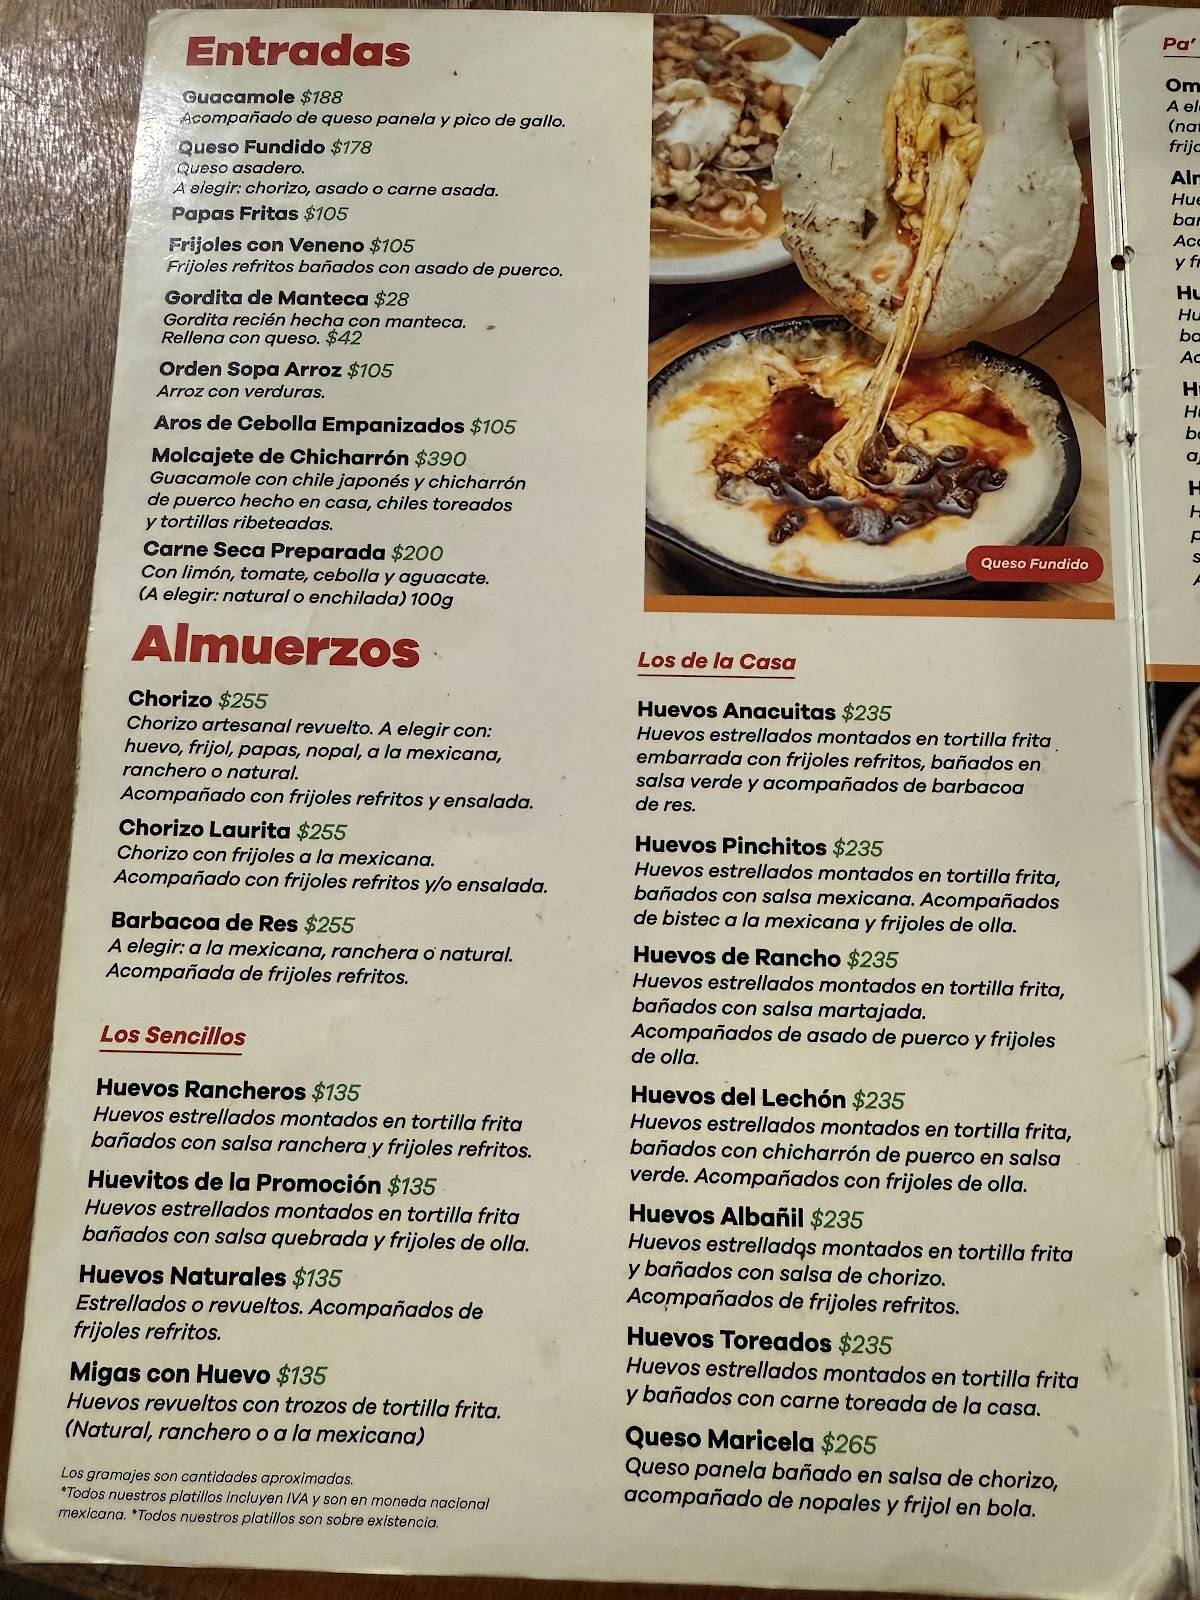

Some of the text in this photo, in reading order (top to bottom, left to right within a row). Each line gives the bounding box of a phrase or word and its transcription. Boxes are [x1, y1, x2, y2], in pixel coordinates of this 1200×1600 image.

[186, 33, 410, 67] Entradas
[182, 89, 343, 105] Guacamole $188
[1166, 100, 1178, 112] A
[178, 139, 372, 157] Queso Fundido $178
[172, 205, 349, 223] Papas Fritas $105
[169, 236, 415, 255] Frijoles con Veneno $105
[1176, 258, 1185, 270] y
[165, 289, 409, 308] Gordita de Manteca $28
[161, 329, 362, 347] Rellena con queso. $42
[159, 361, 394, 379] Orden Sopa Arroz $105
[153, 414, 517, 436] Aros de Cebolla Empanizados $105
[152, 447, 467, 468] Molcajete de Chicharrón $390
[150, 471, 526, 491] Guacamole con chile japonés y chicharrón
[144, 541, 443, 562] Carne Seca Preparada $200
[981, 557, 1089, 570] Queso Fundido
[131, 623, 420, 668] Almuerzos
[638, 652, 796, 670] Los de la Casa
[128, 689, 268, 710] Chorizo $255
[638, 701, 892, 723] Huevos Anacuitas $235
[636, 796, 695, 812] de res.
[119, 818, 348, 841] Chorizo Laurita $255
[636, 835, 884, 858] Huevos Pinchitos $235
[113, 869, 547, 894] Acompañado con frijoles refritos y/o ensalada.
[634, 885, 1059, 911] bañados con salsa mexicana. Acompañados
[112, 911, 356, 935] Barbacoa de Res $255
[634, 945, 899, 970] Huevos de Rancho $235
[100, 1025, 246, 1046] Los Sencillos
[96, 1078, 362, 1102] Huevos Rancheros $135
[632, 1085, 905, 1111] Huevos del Lechón $235
[88, 1169, 437, 1197] Huevitos de la Promoción $135
[630, 1204, 864, 1230] Huevos Albañil $235
[79, 1264, 343, 1289] Huevos Naturales $135
[628, 1326, 893, 1356] Huevos Toreados $235
[70, 1361, 328, 1387] Migas con Huevo $135
[625, 1426, 877, 1455] Queso Maricela $265
[61, 1466, 352, 1486] Los gramajes son cantidades aproximadas.
[109, 1490, 166, 1501] nuestros
[169, 1490, 223, 1504] platillos
[226, 1491, 283, 1506] incluyen
[287, 1492, 308, 1504] IVA
[313, 1496, 321, 1507] y
[323, 1496, 347, 1505] son
[351, 1496, 367, 1506] en
[371, 1495, 426, 1507] moneda
[430, 1497, 490, 1510] nacional
[624, 1489, 1035, 1518] acompañado de nopales y frijol en bola.
[58, 1507, 124, 1520] mexicana.
[180, 1512, 238, 1523] nuestros
[241, 1512, 295, 1526] platillos
[298, 1516, 322, 1525] son
[326, 1513, 364, 1526] sobre
[368, 1515, 438, 1528] existencia.
